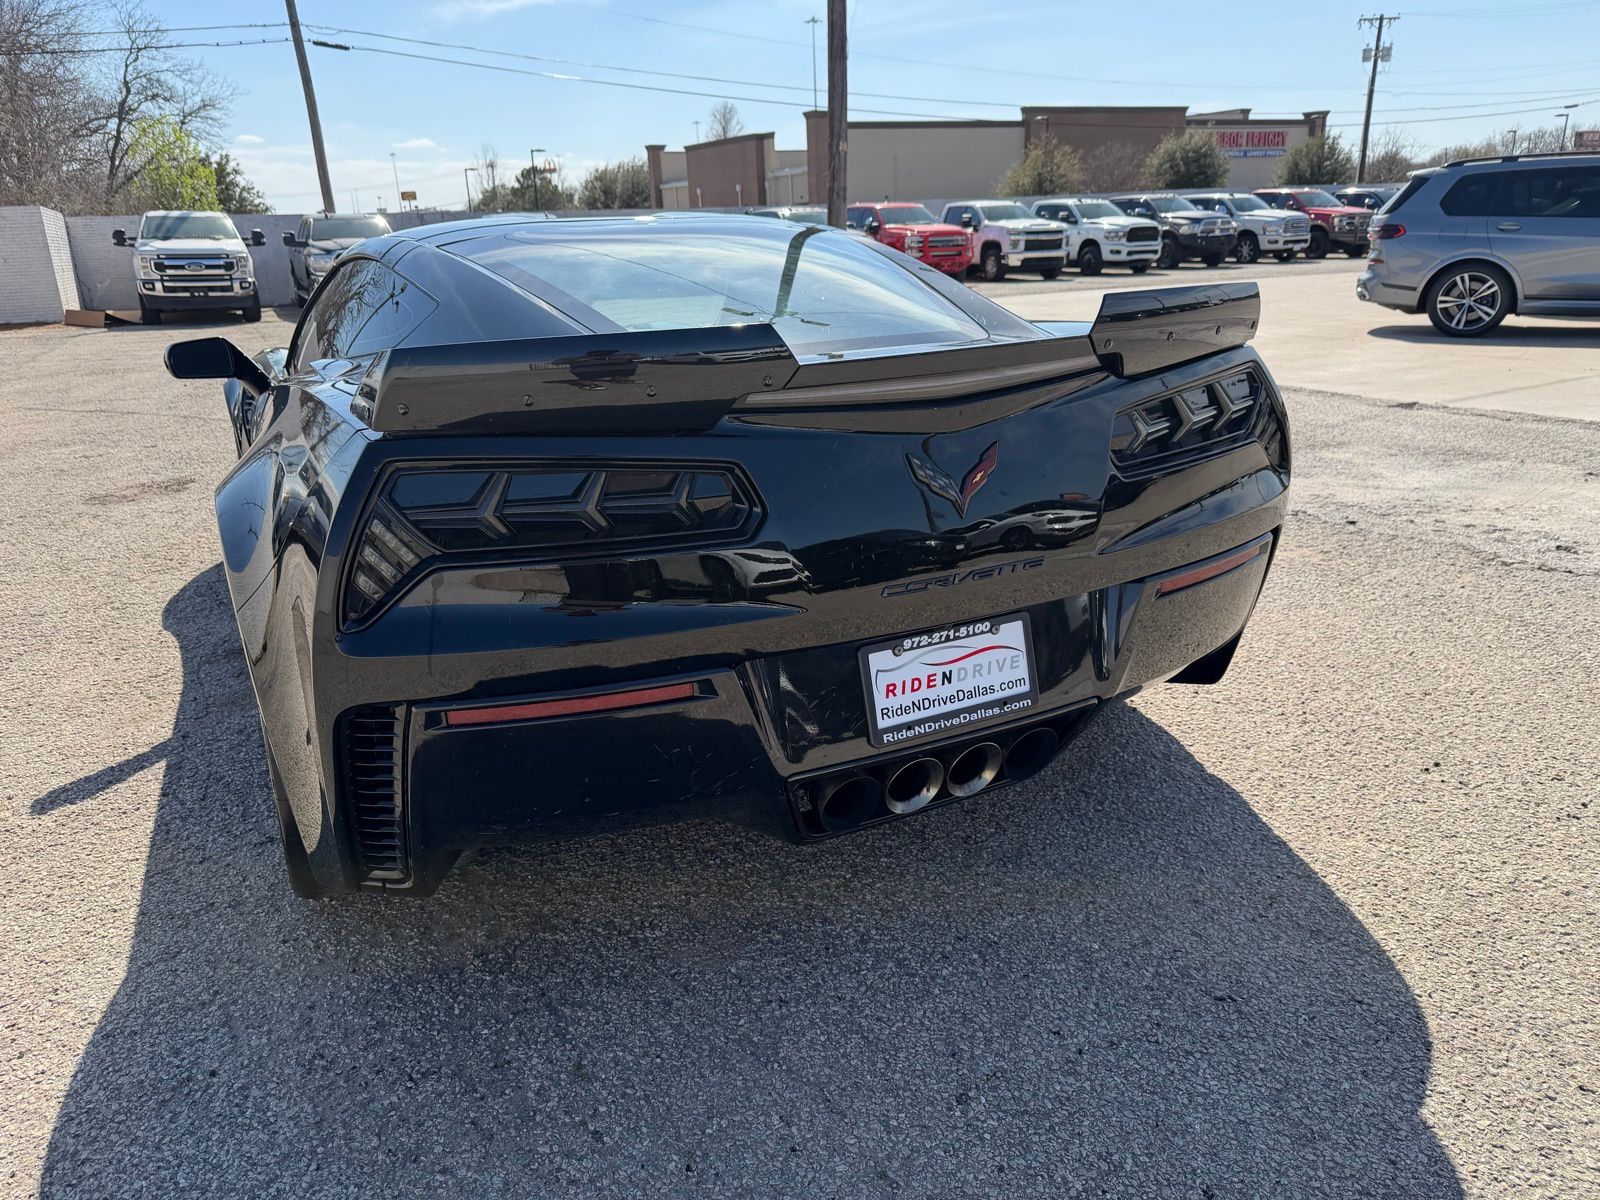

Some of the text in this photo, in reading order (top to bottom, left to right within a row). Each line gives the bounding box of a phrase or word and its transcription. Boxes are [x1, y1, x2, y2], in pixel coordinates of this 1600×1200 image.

[881, 555, 1045, 598] CORVETTE
[903, 621, 991, 649] 972-271-5100
[880, 677, 1026, 720] RideNDriveDallas.com
[883, 699, 1032, 743] RideNDriveDallas.com
